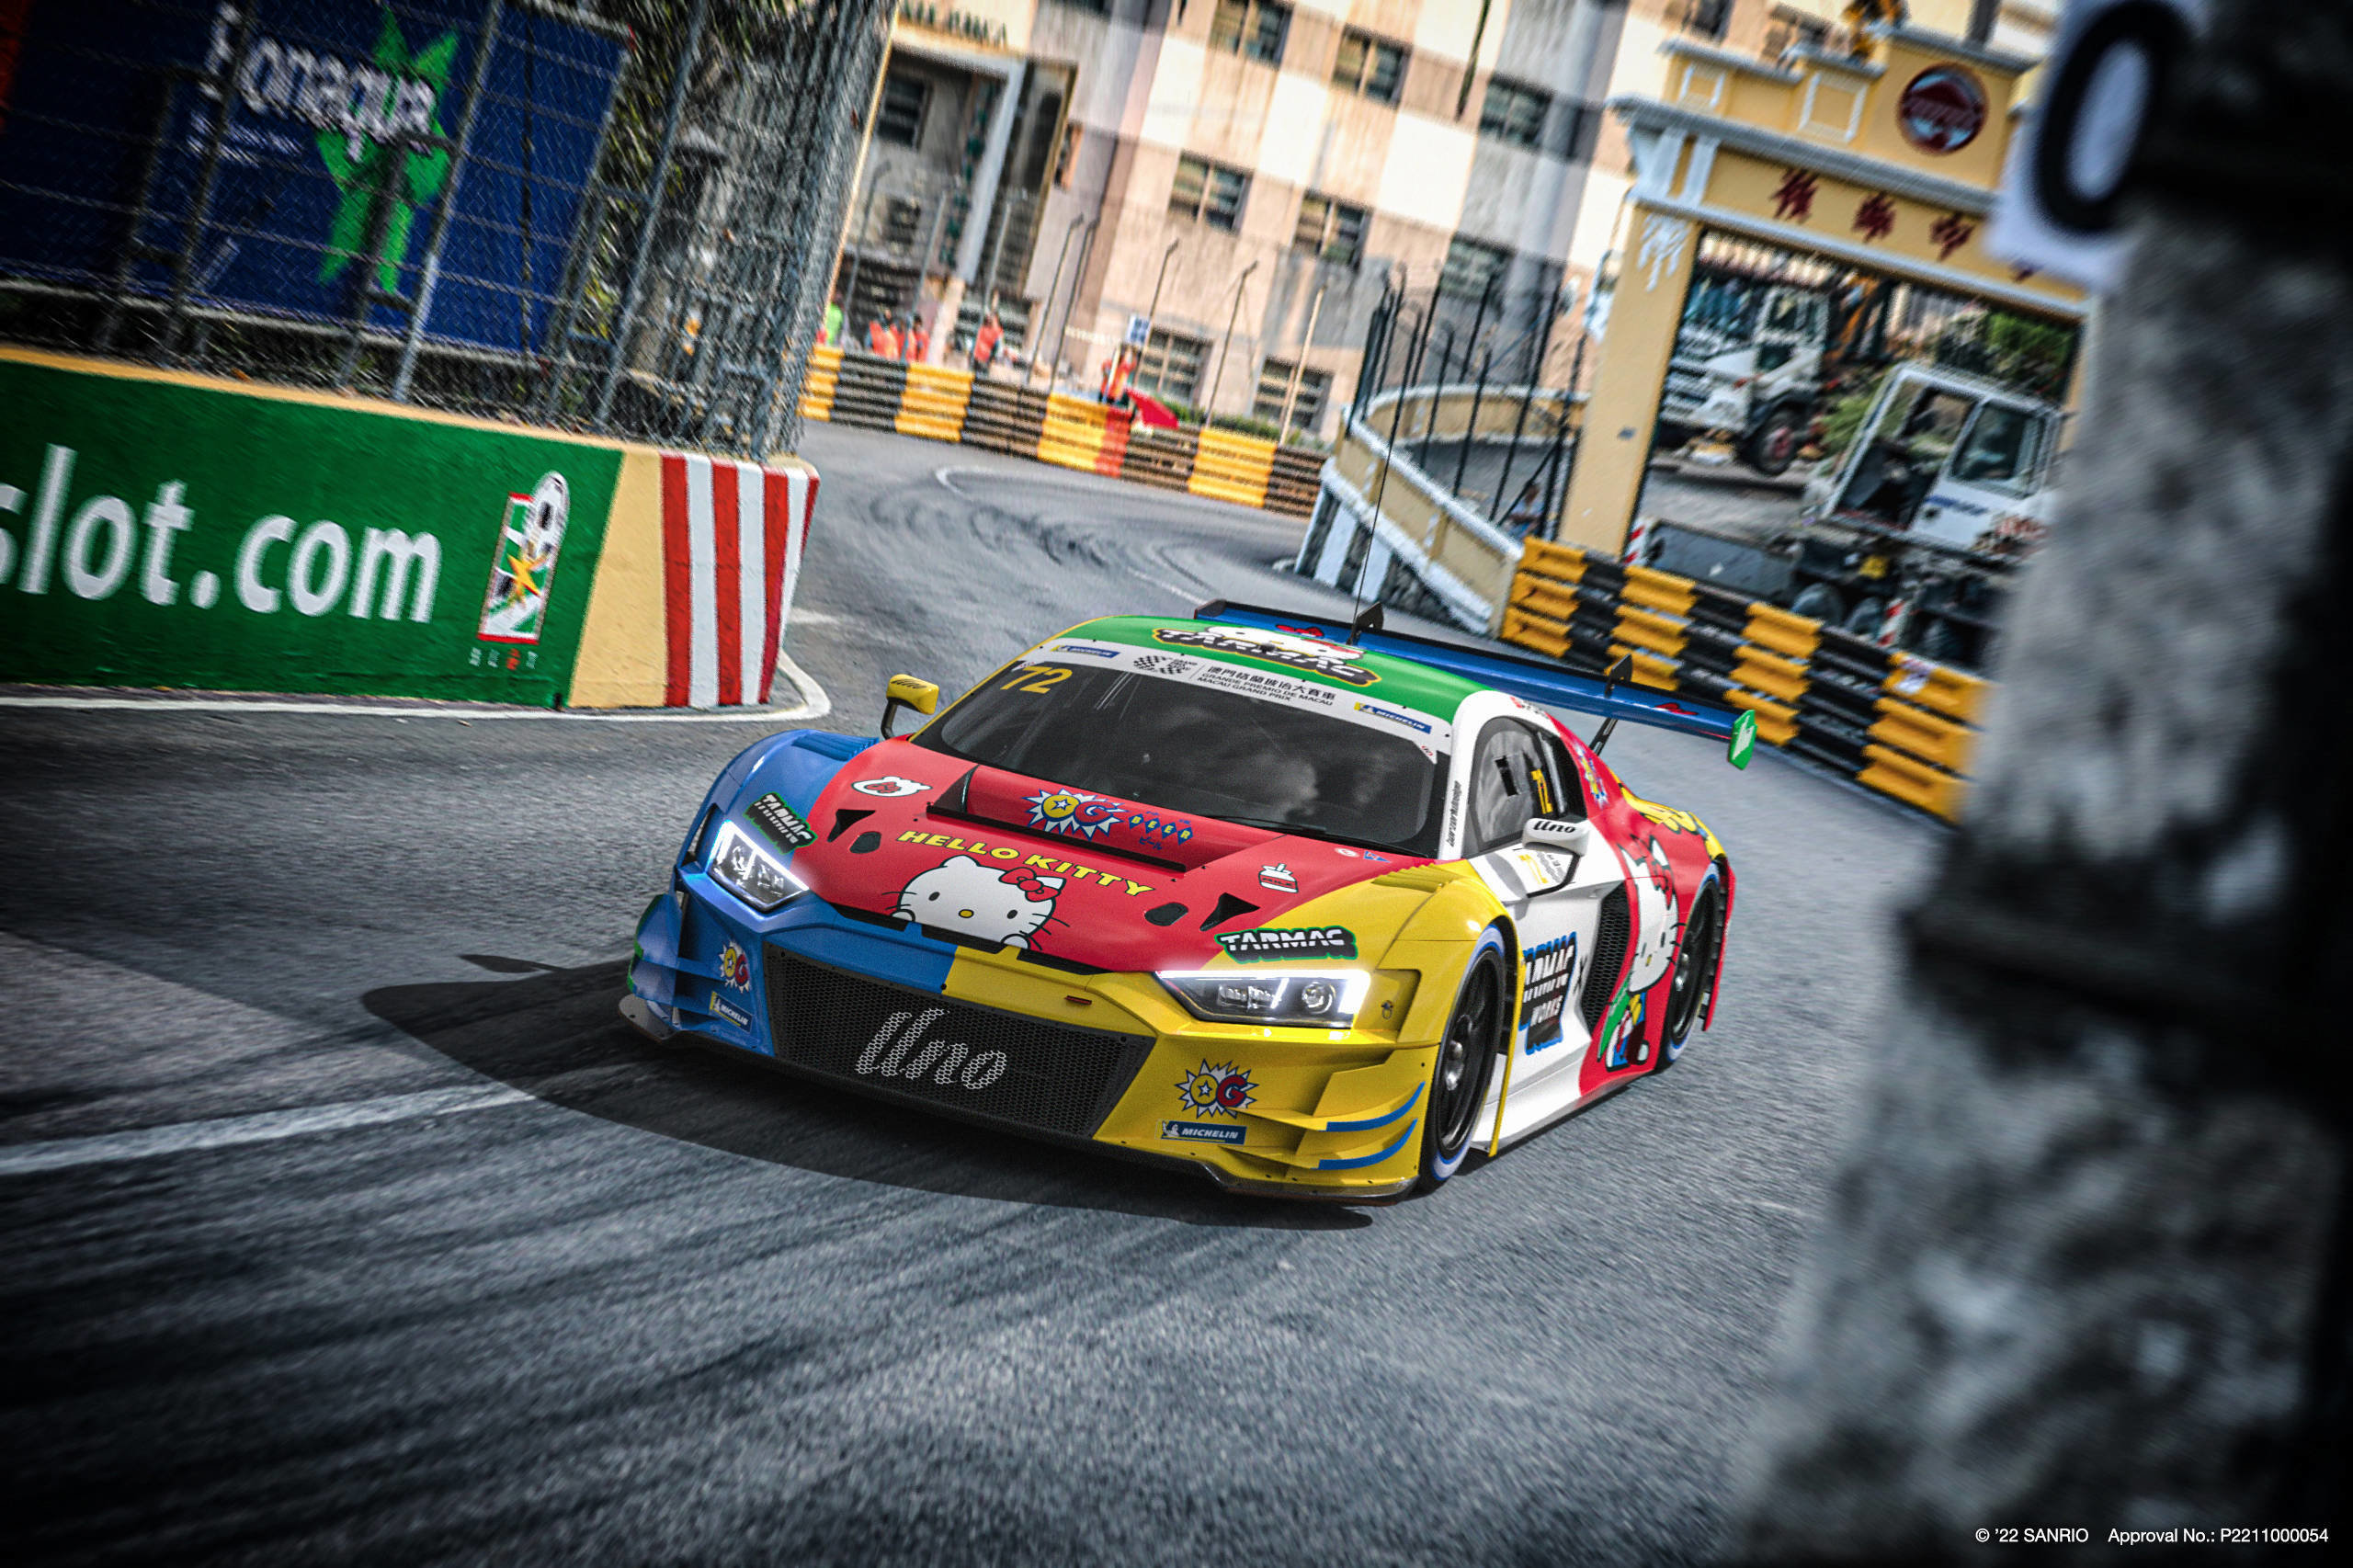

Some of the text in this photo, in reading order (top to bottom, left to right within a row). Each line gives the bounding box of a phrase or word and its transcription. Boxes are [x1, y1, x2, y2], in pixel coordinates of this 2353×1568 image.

[1000, 666, 1073, 694] 72
[1197, 676, 1232, 687] MACAU
[1232, 684, 1267, 696] GRAND
[1298, 694, 1333, 706] MACAU
[754, 793, 813, 844] TARMAC
[1130, 814, 1192, 841] BEER
[897, 831, 1155, 897] HELLO KITTY
[1220, 928, 1346, 951] TARMAC
[720, 1004, 749, 1026] MICHELIN
[1181, 1127, 1239, 1140] MICHELIN
